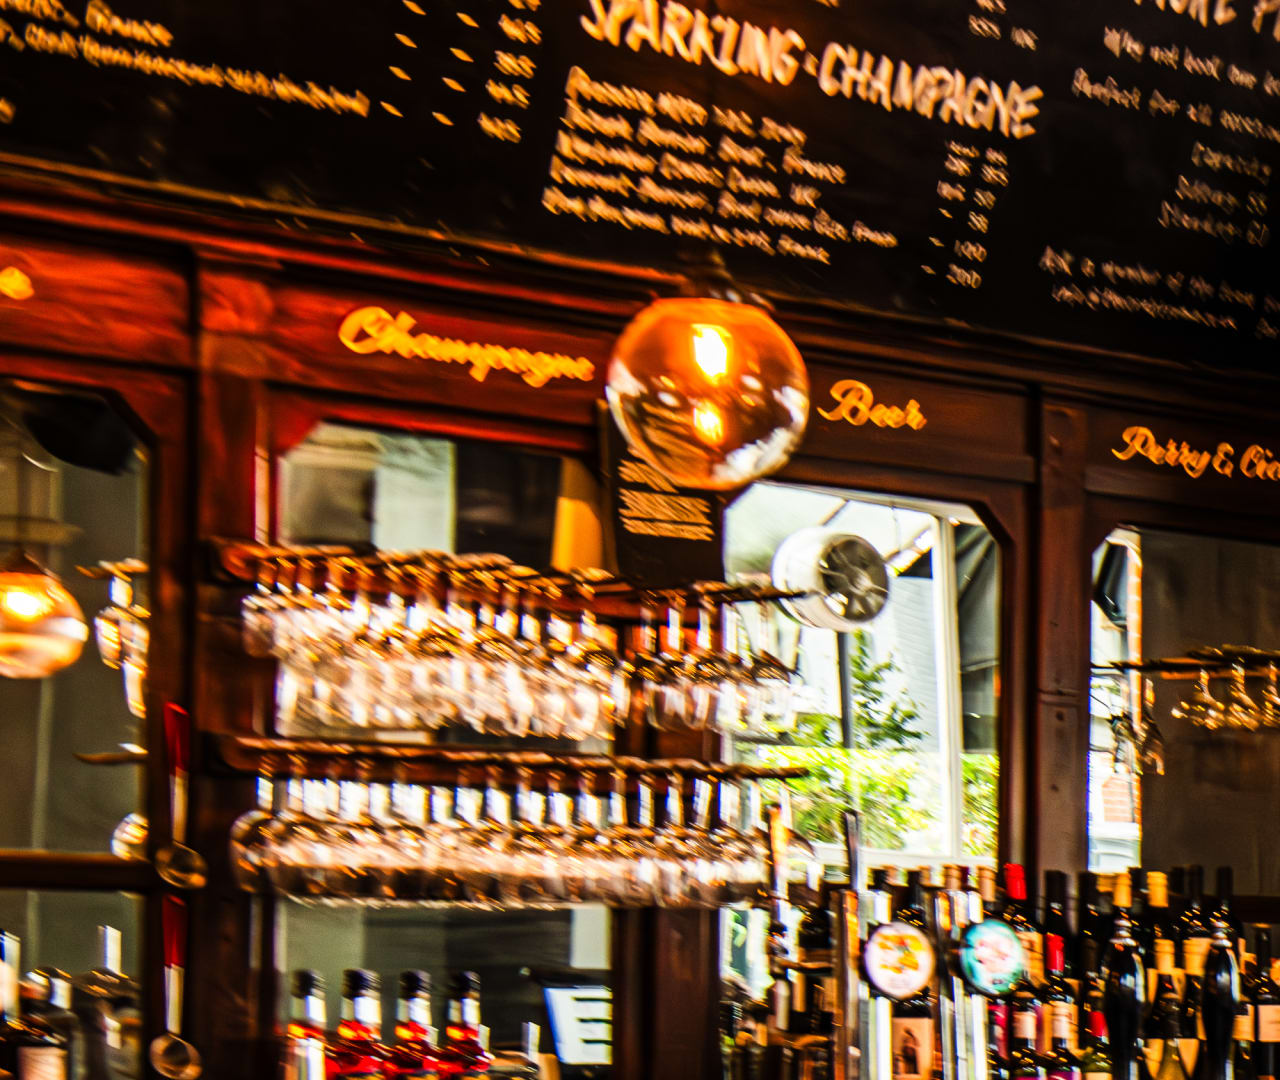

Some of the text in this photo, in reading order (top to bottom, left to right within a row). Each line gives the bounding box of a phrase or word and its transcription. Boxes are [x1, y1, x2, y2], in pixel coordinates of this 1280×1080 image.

[338, 306, 596, 388] Champagne
[816, 379, 928, 431] Beer
[1111, 426, 1212, 479] Perry
[1212, 442, 1235, 478] &
